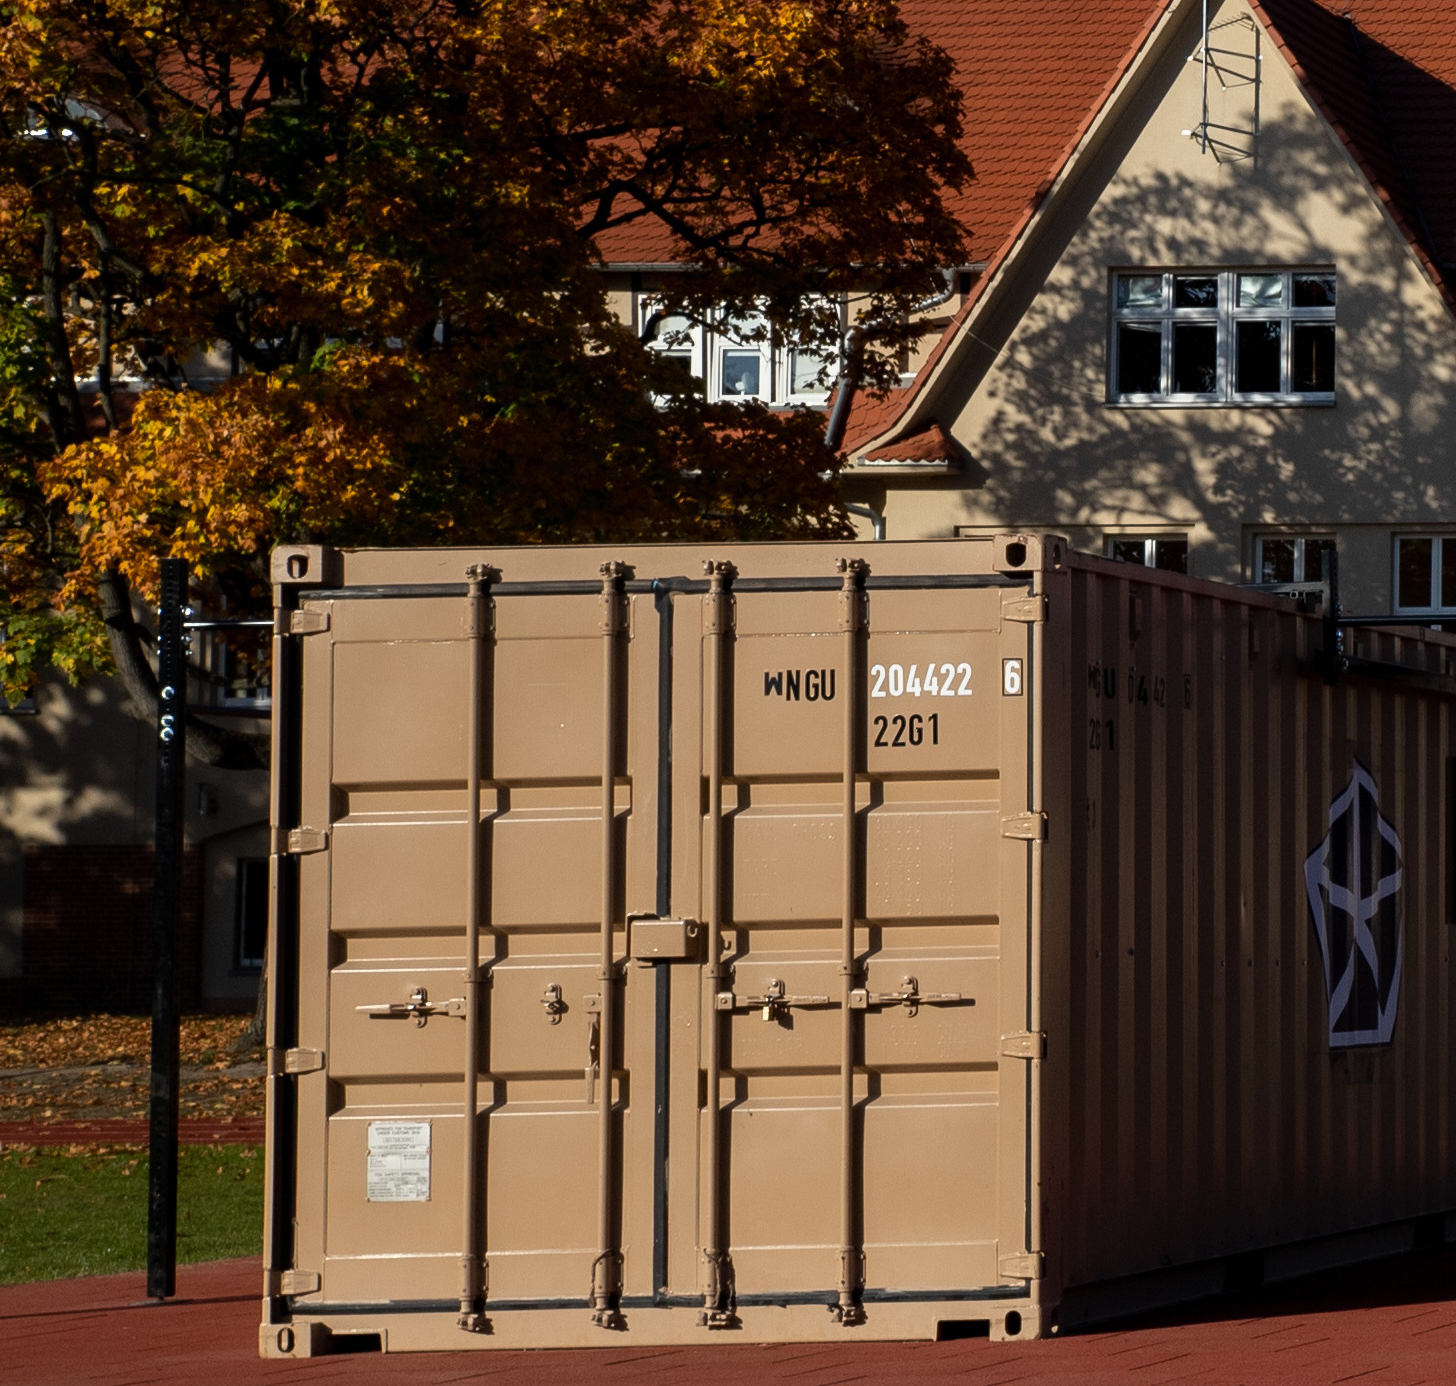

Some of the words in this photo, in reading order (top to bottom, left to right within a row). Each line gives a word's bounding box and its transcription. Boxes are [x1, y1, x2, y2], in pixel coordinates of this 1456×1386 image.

[764, 668, 836, 702] WNGU
[870, 662, 973, 698] 204422
[1003, 659, 1021, 694] 6
[873, 712, 939, 748] 22G1
